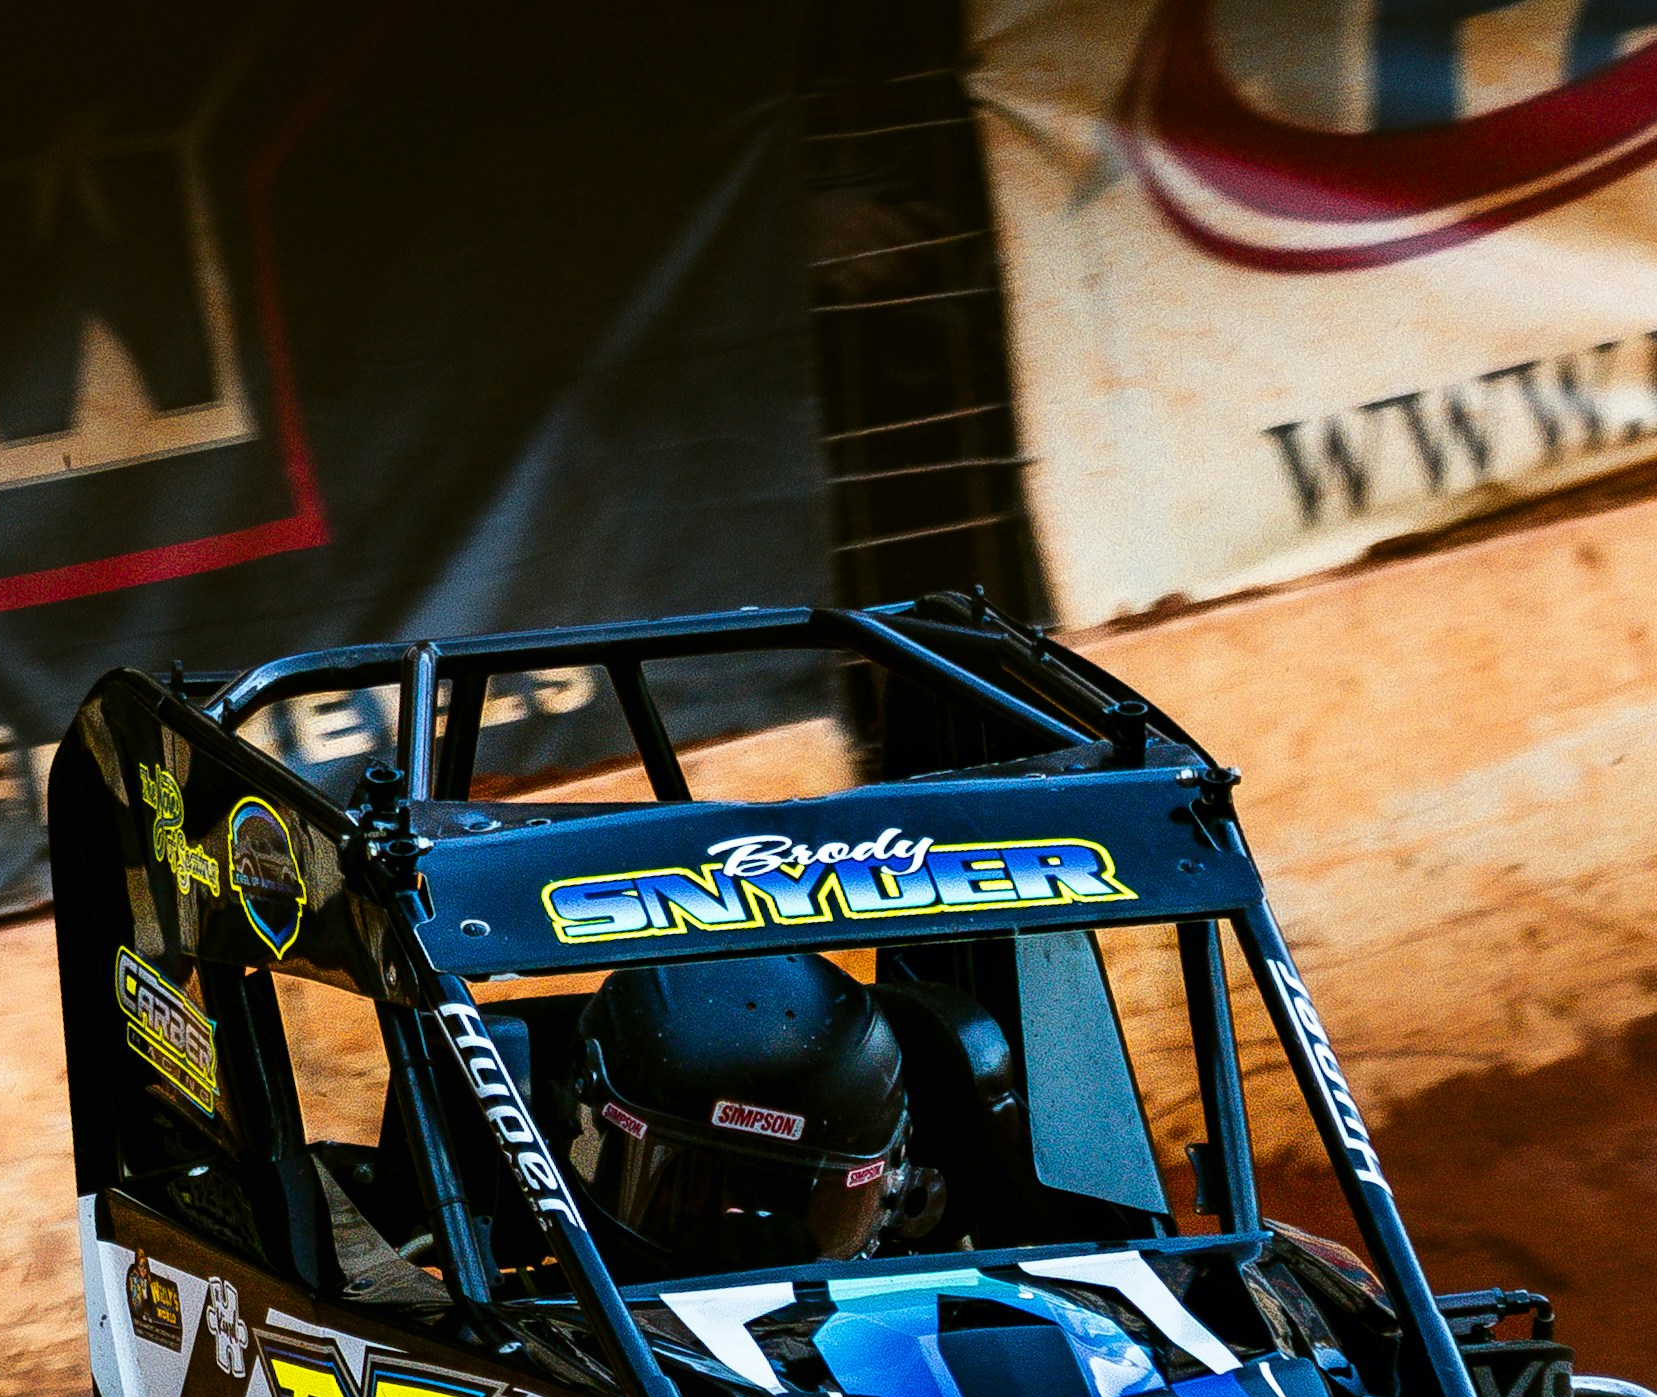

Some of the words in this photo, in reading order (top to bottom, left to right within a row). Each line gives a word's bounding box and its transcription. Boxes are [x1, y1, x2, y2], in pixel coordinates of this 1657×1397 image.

[707, 828, 934, 878] Brody
[546, 843, 1114, 940] SNYDER
[435, 1003, 587, 1232] Hyper
[604, 1105, 644, 1138] SIMPSON
[717, 1104, 797, 1138] SIMPSON
